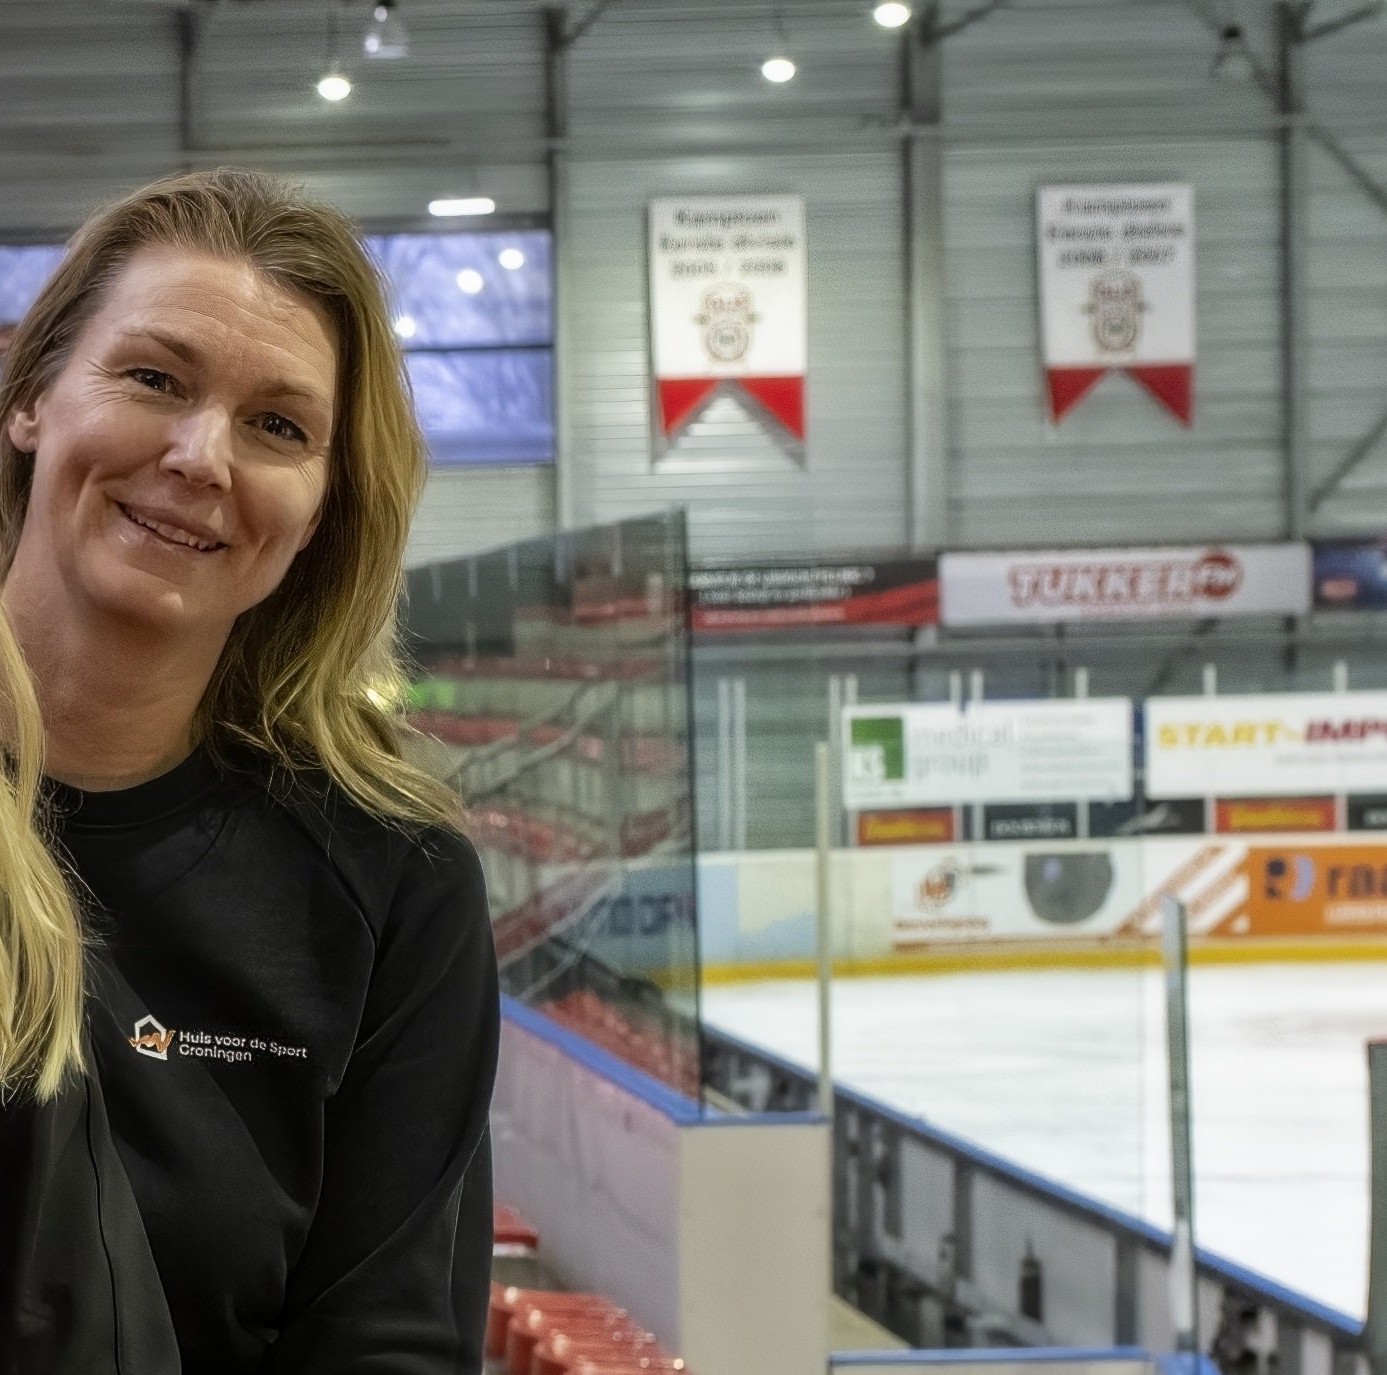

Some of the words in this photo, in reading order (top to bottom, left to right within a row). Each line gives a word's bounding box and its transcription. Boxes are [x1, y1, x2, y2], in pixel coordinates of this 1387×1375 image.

[1007, 561, 1198, 606] TUKKER
[913, 720, 1009, 749] medical
[912, 751, 990, 779] group
[179, 1031, 212, 1045] Huis
[214, 1035, 247, 1048] voor
[250, 1037, 267, 1051] de
[269, 1042, 308, 1059] Sport
[179, 1043, 253, 1063] Groningen
